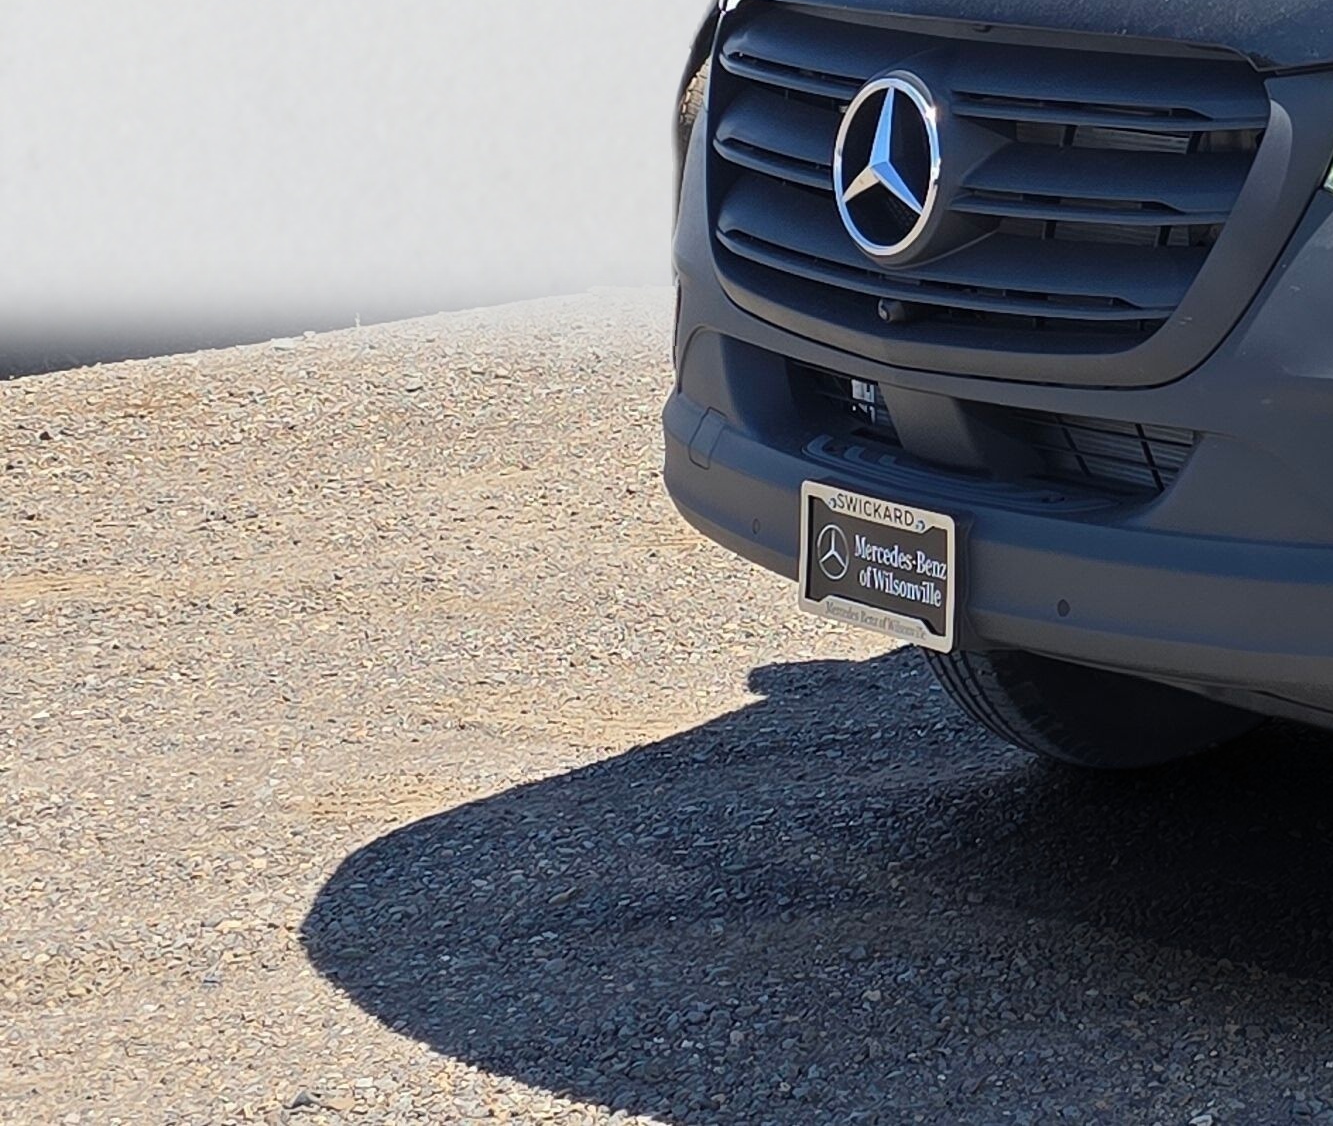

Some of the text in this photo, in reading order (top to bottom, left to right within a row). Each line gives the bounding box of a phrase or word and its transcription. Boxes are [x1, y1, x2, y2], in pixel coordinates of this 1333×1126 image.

[836, 492, 915, 527] SWICKARD
[854, 534, 947, 581] Mercedes-Benz
[858, 566, 942, 608] of Wilsonville
